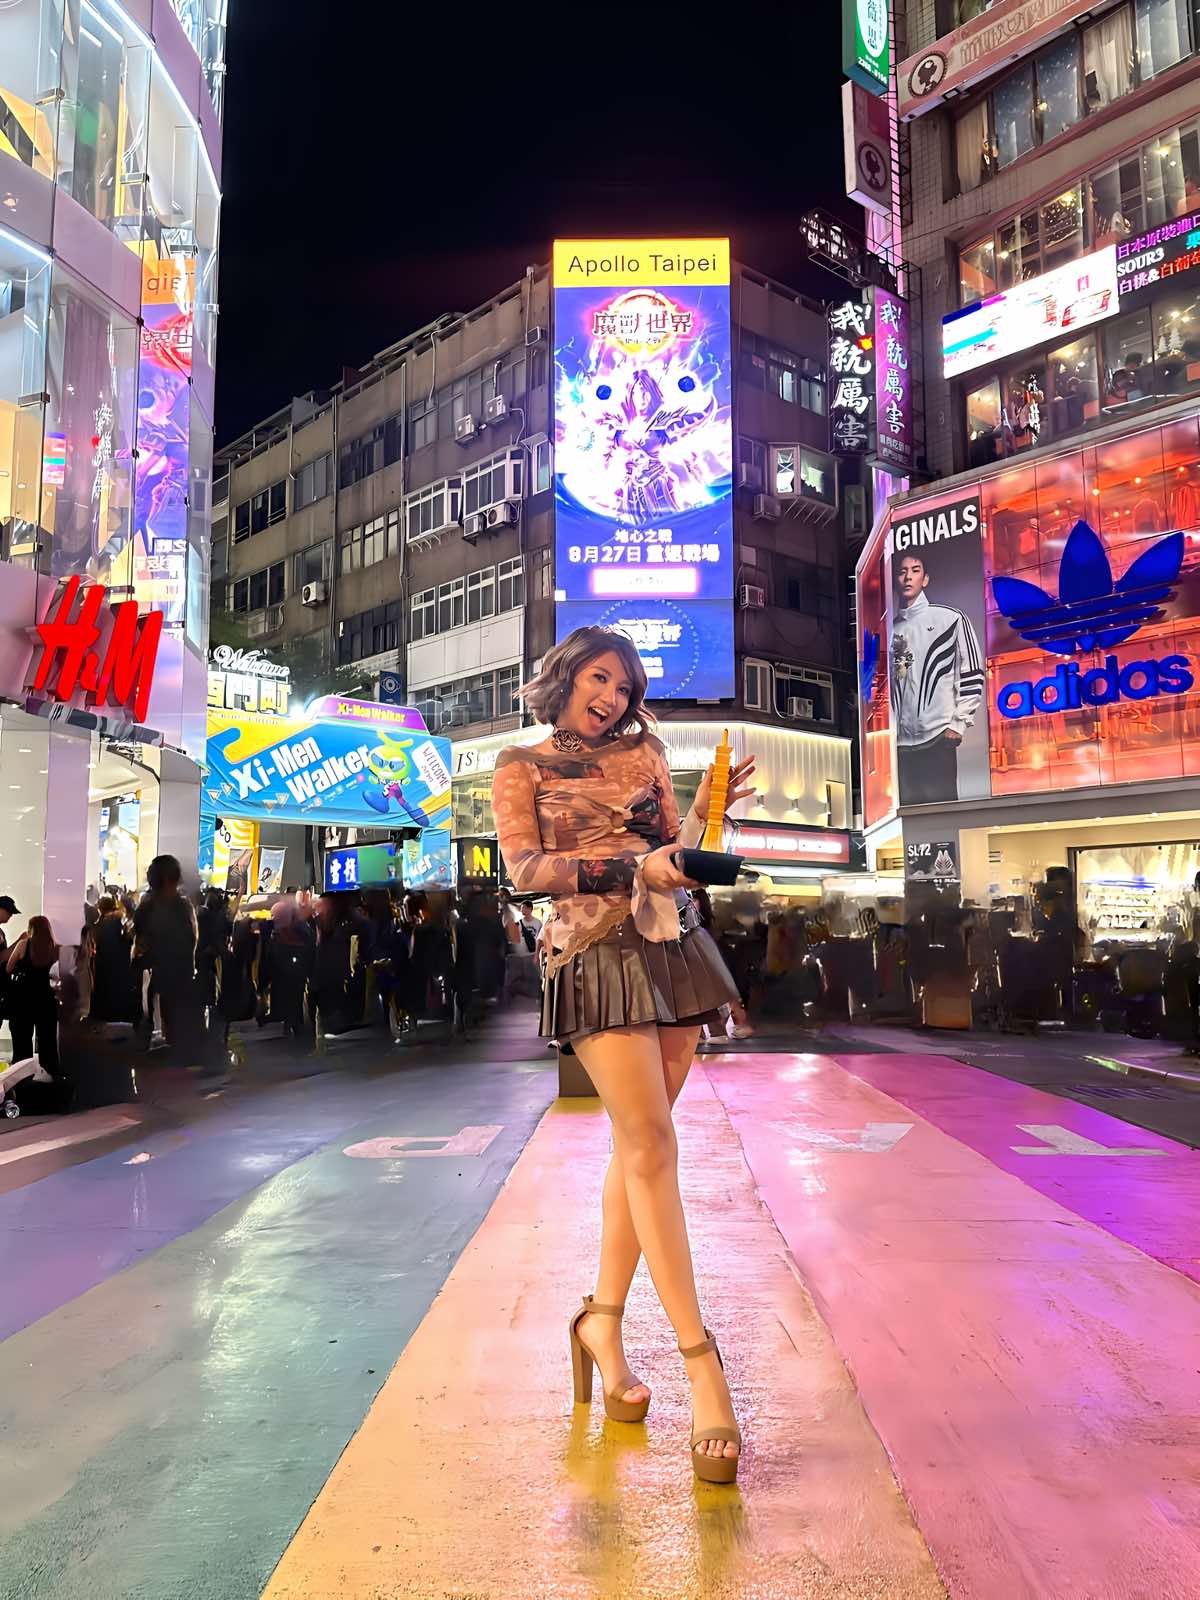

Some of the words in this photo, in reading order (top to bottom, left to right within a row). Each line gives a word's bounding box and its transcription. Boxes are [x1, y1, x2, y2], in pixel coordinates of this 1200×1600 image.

[568, 255, 641, 277] Apollo
[649, 254, 717, 275] Taipei
[1117, 247, 1165, 277] SOUR3
[568, 546, 641, 563] 8月27日
[34, 574, 164, 724] H&M
[997, 654, 1195, 719] adidas
[229, 736, 323, 800] Xi-Men
[285, 744, 370, 804] Walker
[423, 745, 451, 787] WELCOME
